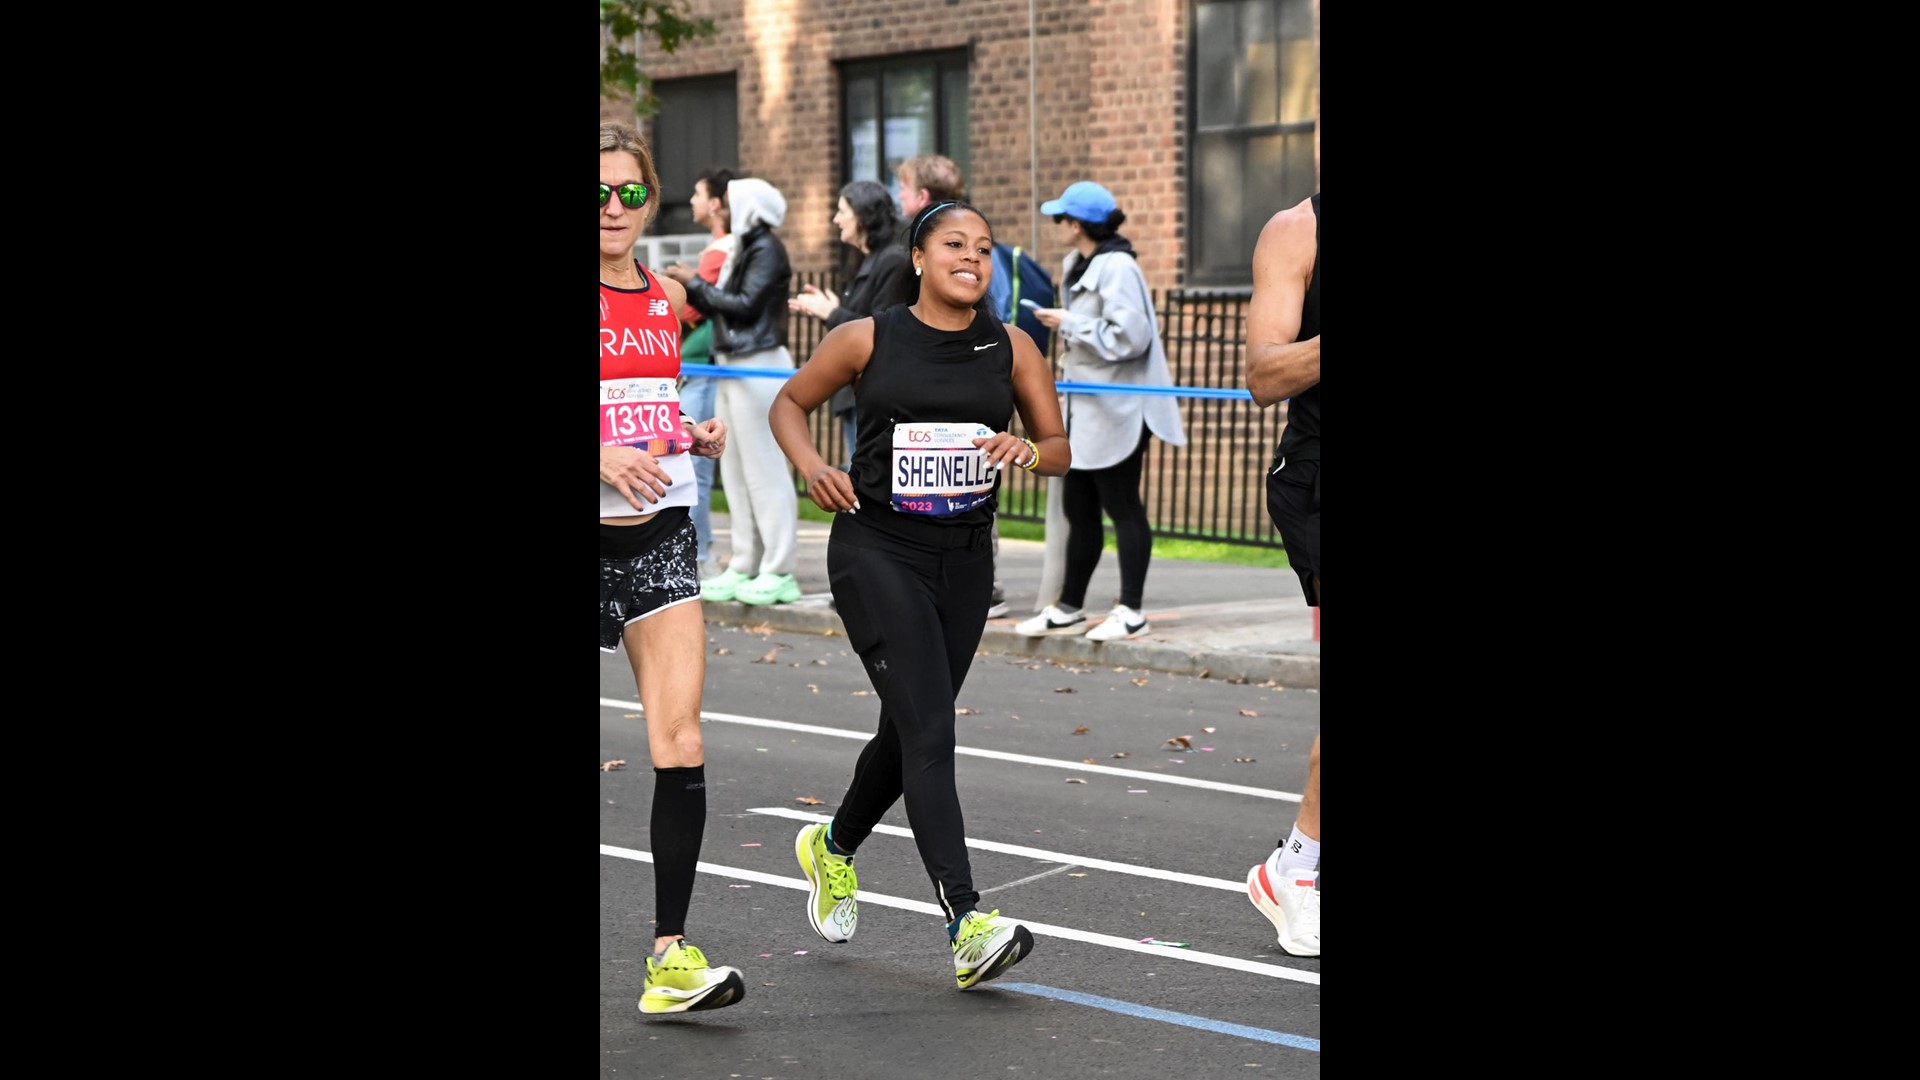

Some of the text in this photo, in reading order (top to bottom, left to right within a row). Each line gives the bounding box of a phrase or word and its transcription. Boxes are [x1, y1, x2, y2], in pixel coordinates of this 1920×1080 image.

[600, 327, 678, 358] RAINY
[605, 404, 674, 437] 13178
[908, 427, 932, 443] tcs
[897, 455, 995, 487] SHEINELLE
[901, 501, 933, 511] 2023
